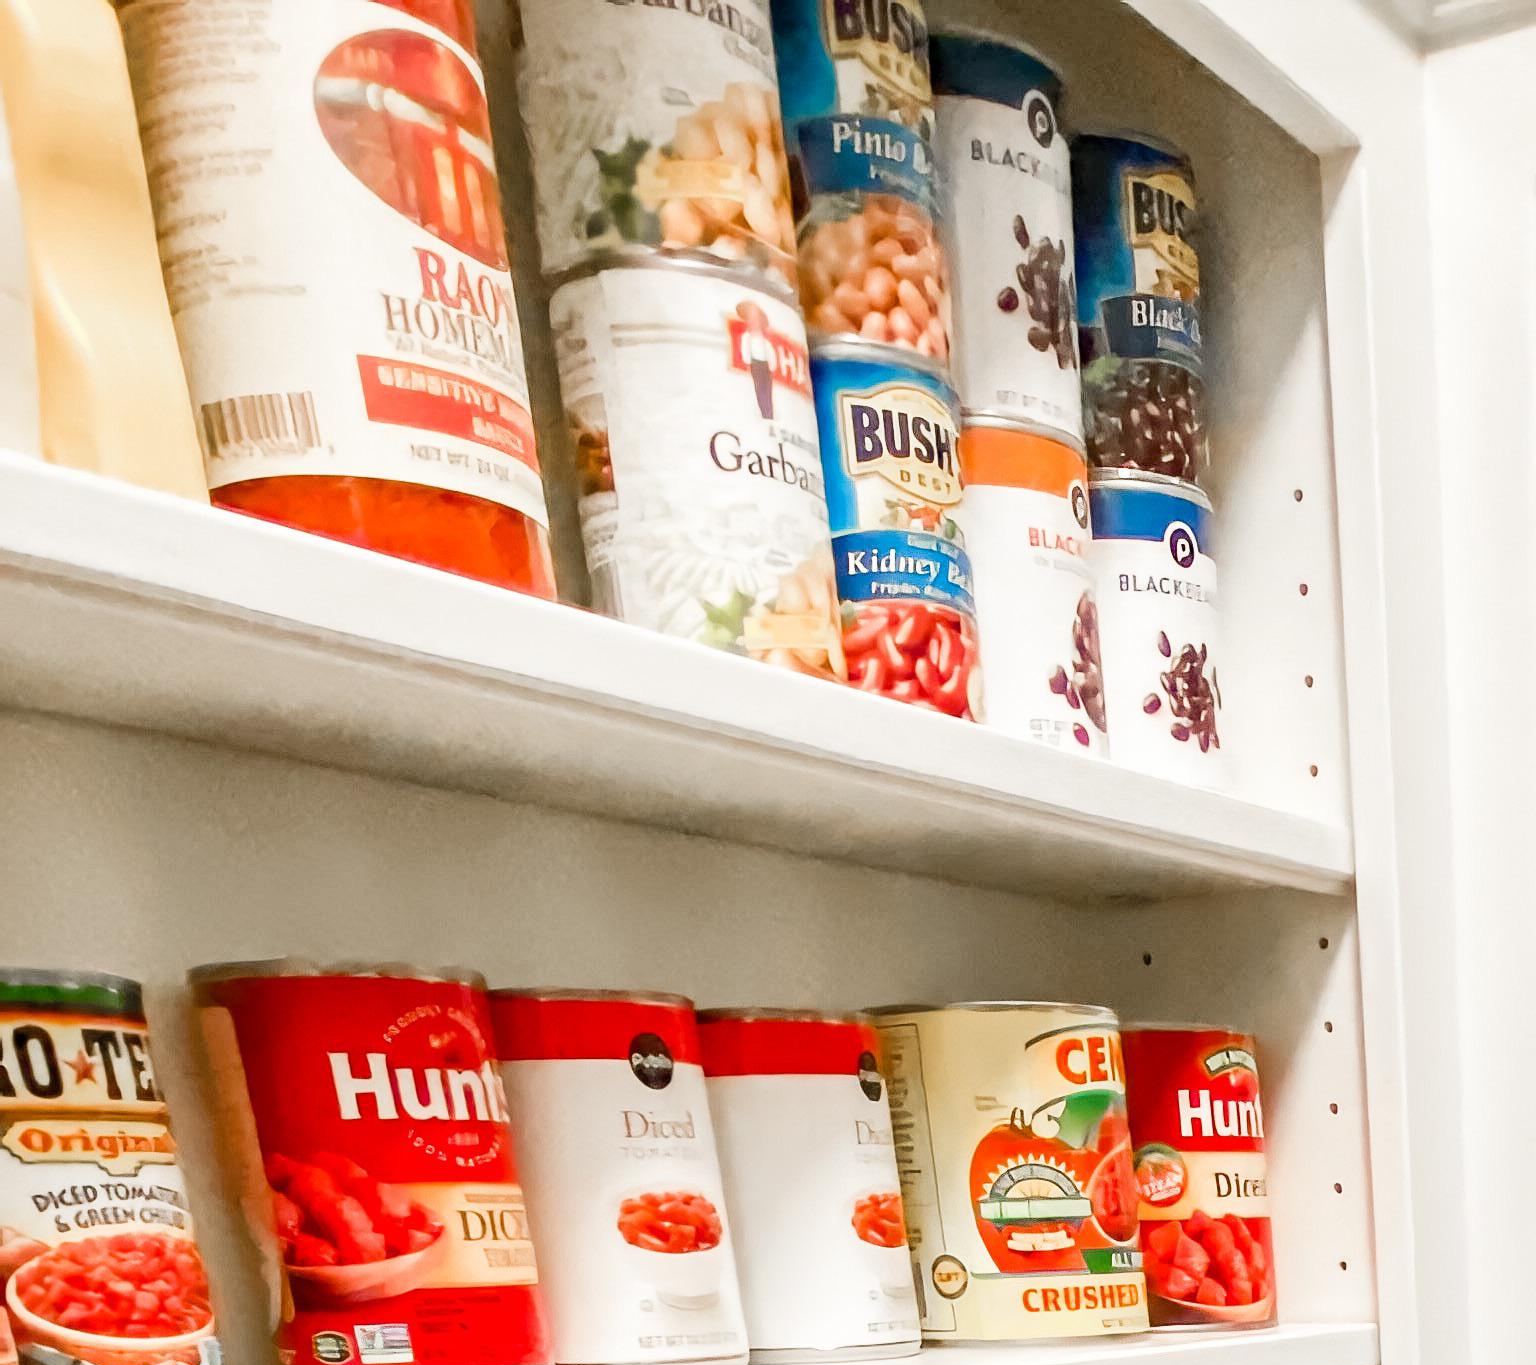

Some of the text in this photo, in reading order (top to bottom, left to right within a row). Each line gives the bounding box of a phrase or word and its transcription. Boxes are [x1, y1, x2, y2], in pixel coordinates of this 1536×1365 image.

[832, 121, 906, 163] Pinto
[848, 549, 941, 583] Kidney
[328, 1051, 510, 1124] Hunt
[31, 1184, 98, 1213] DICED
[73, 1206, 136, 1230] GREEN
[1022, 1284, 1140, 1314] CRUSHED
